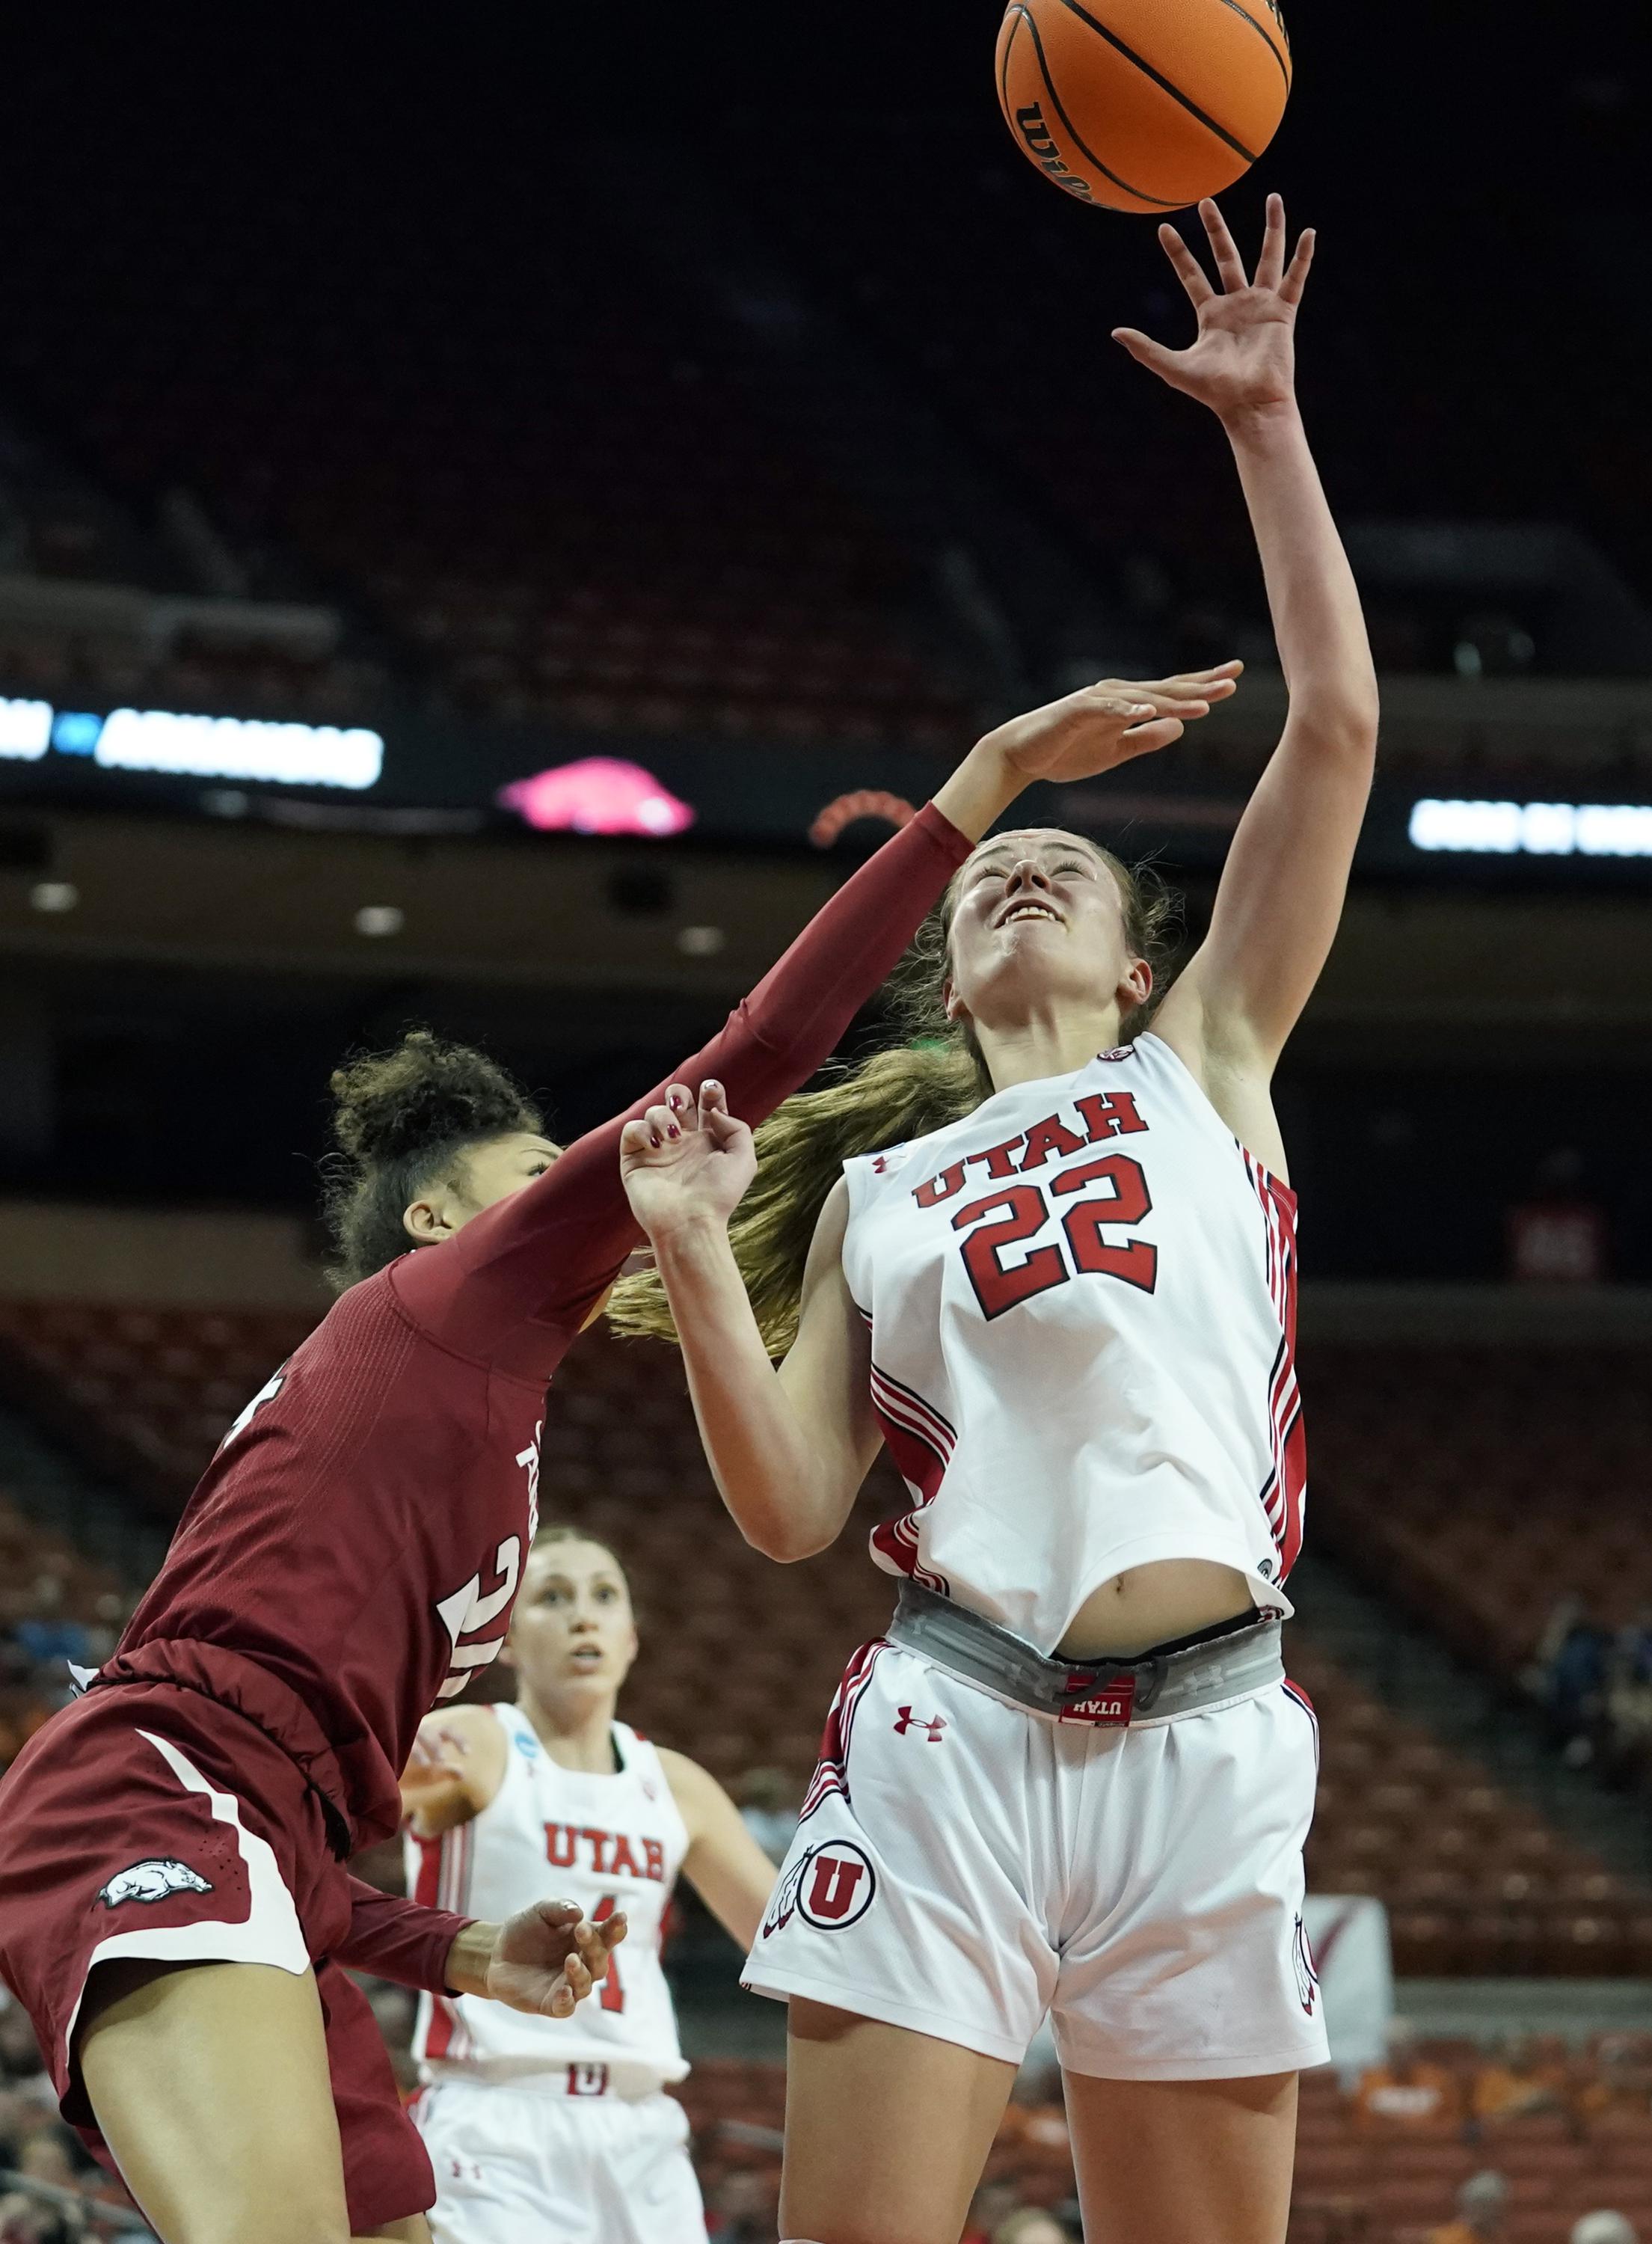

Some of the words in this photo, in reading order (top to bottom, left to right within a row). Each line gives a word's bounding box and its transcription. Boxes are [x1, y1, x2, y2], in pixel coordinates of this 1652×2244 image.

[912, 1091, 1149, 1209] UTAH
[951, 1153, 1158, 1322] 22
[1073, 1700, 1122, 1714] UTAH
[543, 1821, 665, 1883] UTAH
[808, 1855, 864, 1919] U
